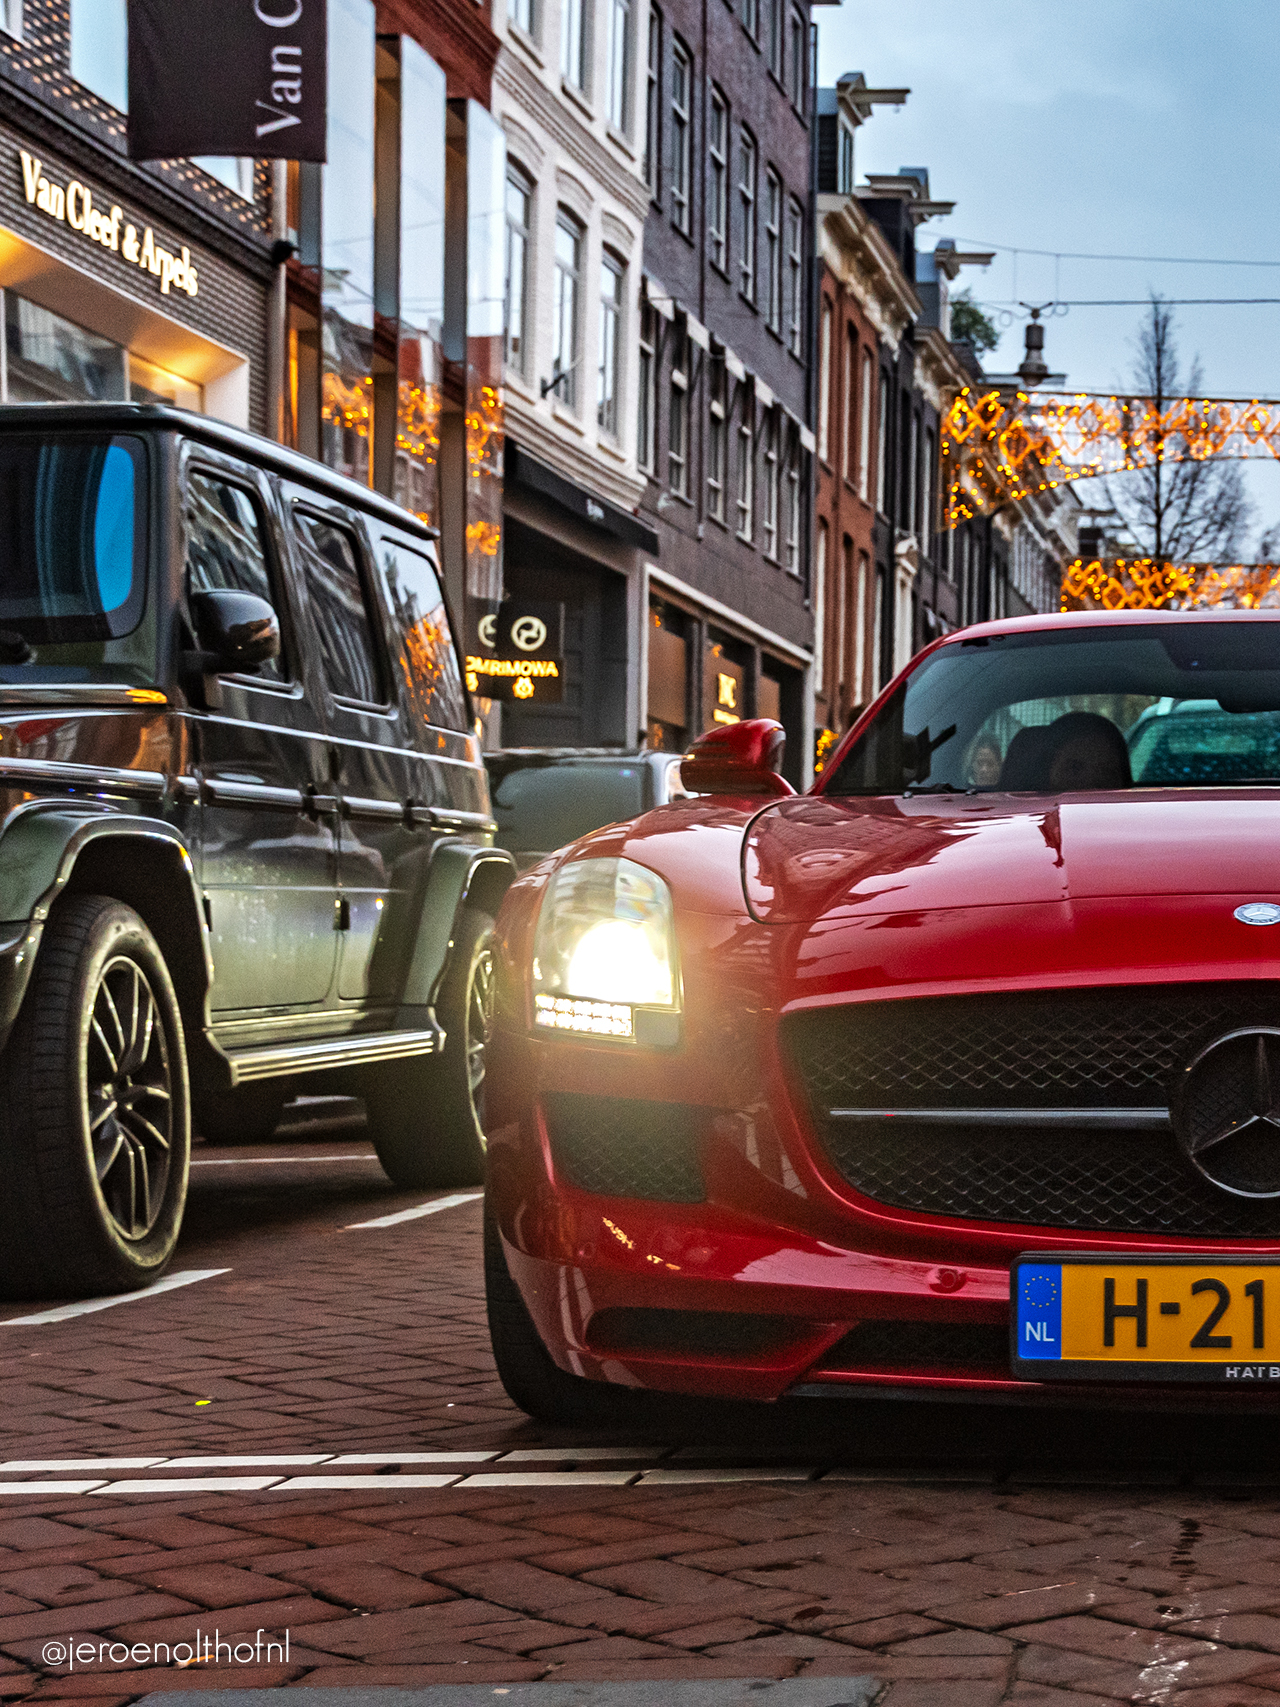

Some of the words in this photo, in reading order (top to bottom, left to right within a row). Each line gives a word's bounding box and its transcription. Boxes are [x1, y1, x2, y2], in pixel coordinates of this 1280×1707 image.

[255, 45, 302, 137] Van
[20, 150, 65, 220] Van
[66, 180, 123, 250] Cleef
[122, 224, 141, 263] &
[138, 226, 198, 296] Arpels
[489, 659, 559, 677] RIMOWA
[1025, 1321, 1055, 1343] NL
